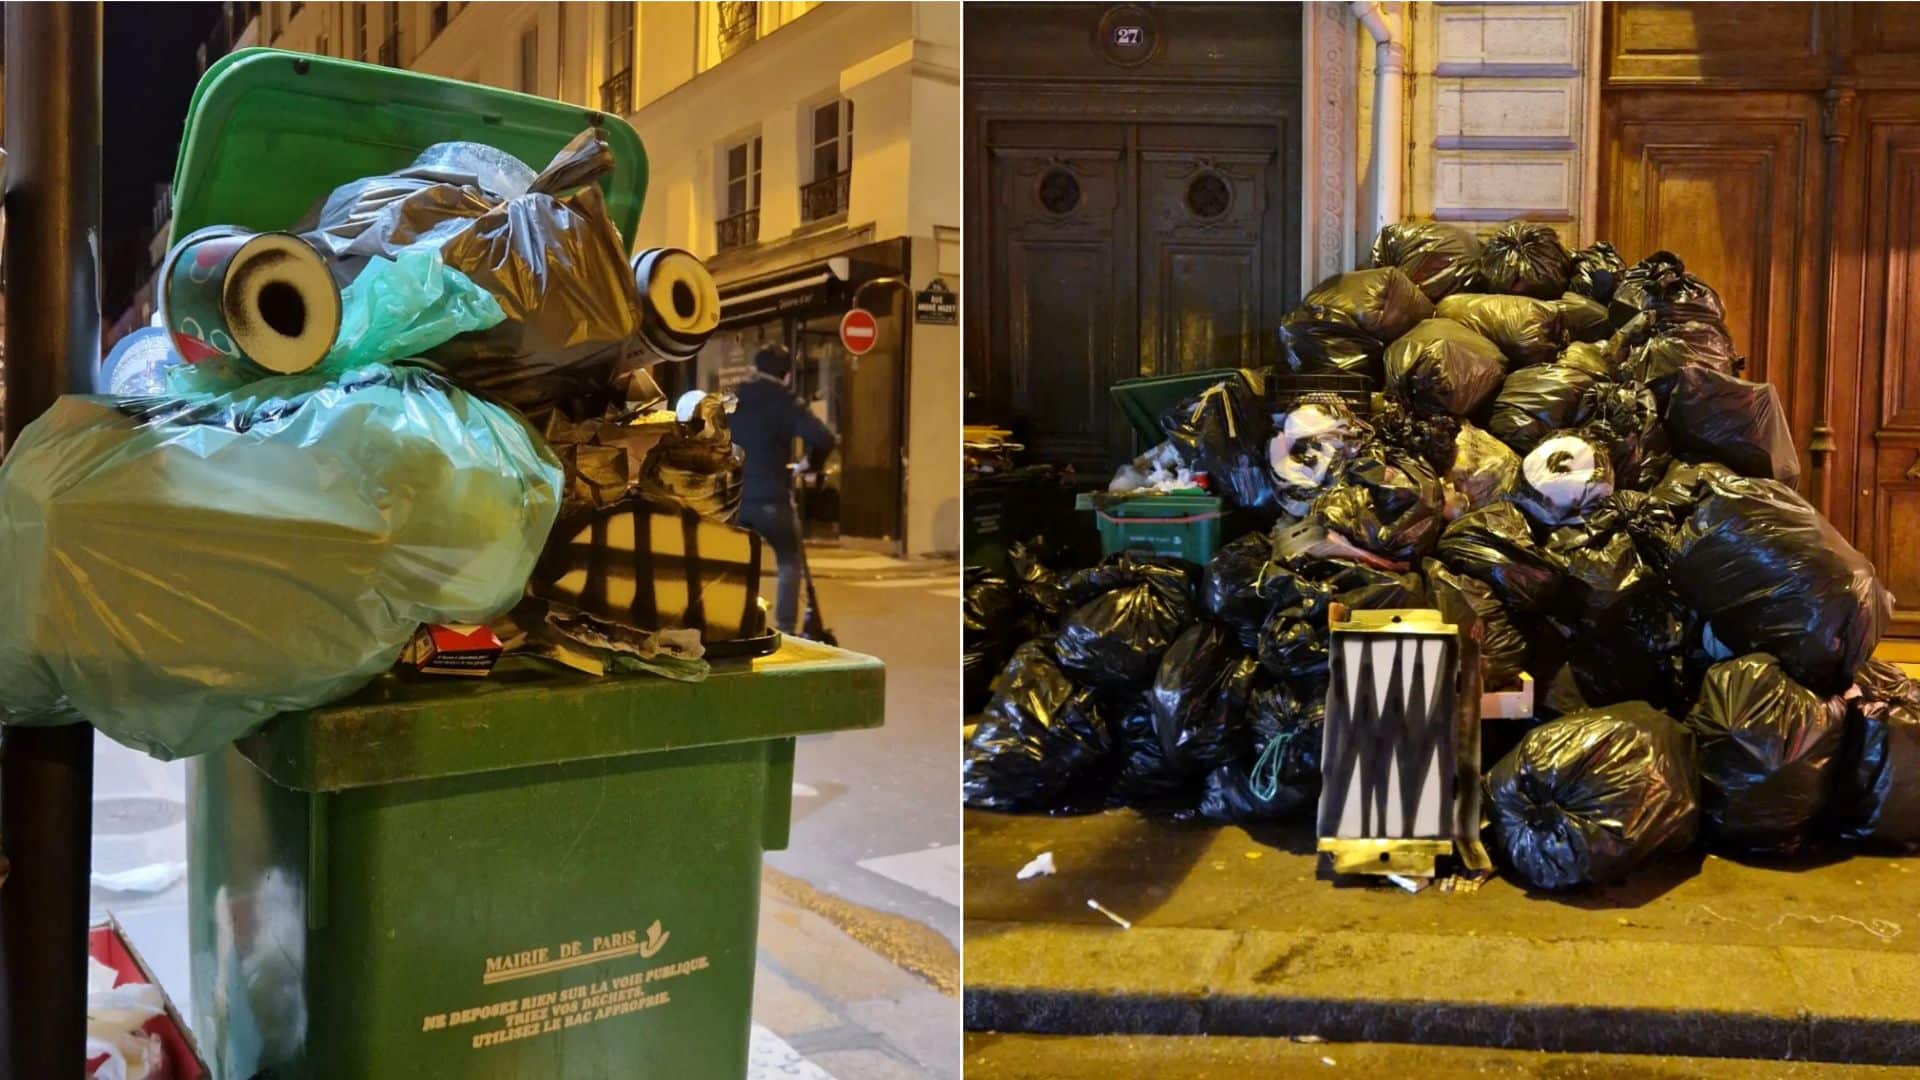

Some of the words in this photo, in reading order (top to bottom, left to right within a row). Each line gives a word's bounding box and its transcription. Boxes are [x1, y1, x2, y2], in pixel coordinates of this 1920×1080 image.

[1118, 28, 1138, 43] 27
[486, 947, 549, 972] MAIRIE
[560, 941, 582, 958] DE
[593, 930, 637, 951] PARIS
[422, 1015, 446, 1032] NE
[449, 1001, 518, 1026] DEPOSEZ
[521, 992, 556, 1010] RIEN
[560, 986, 588, 1001] SUR
[590, 982, 609, 995] LA
[612, 973, 644, 988] VOIE
[505, 1009, 548, 1027] TRIEZ
[552, 1002, 578, 1017] VOS
[472, 1025, 540, 1048] UTILISEZ
[543, 1018, 561, 1032] LE
[564, 1011, 592, 1027] BAC
